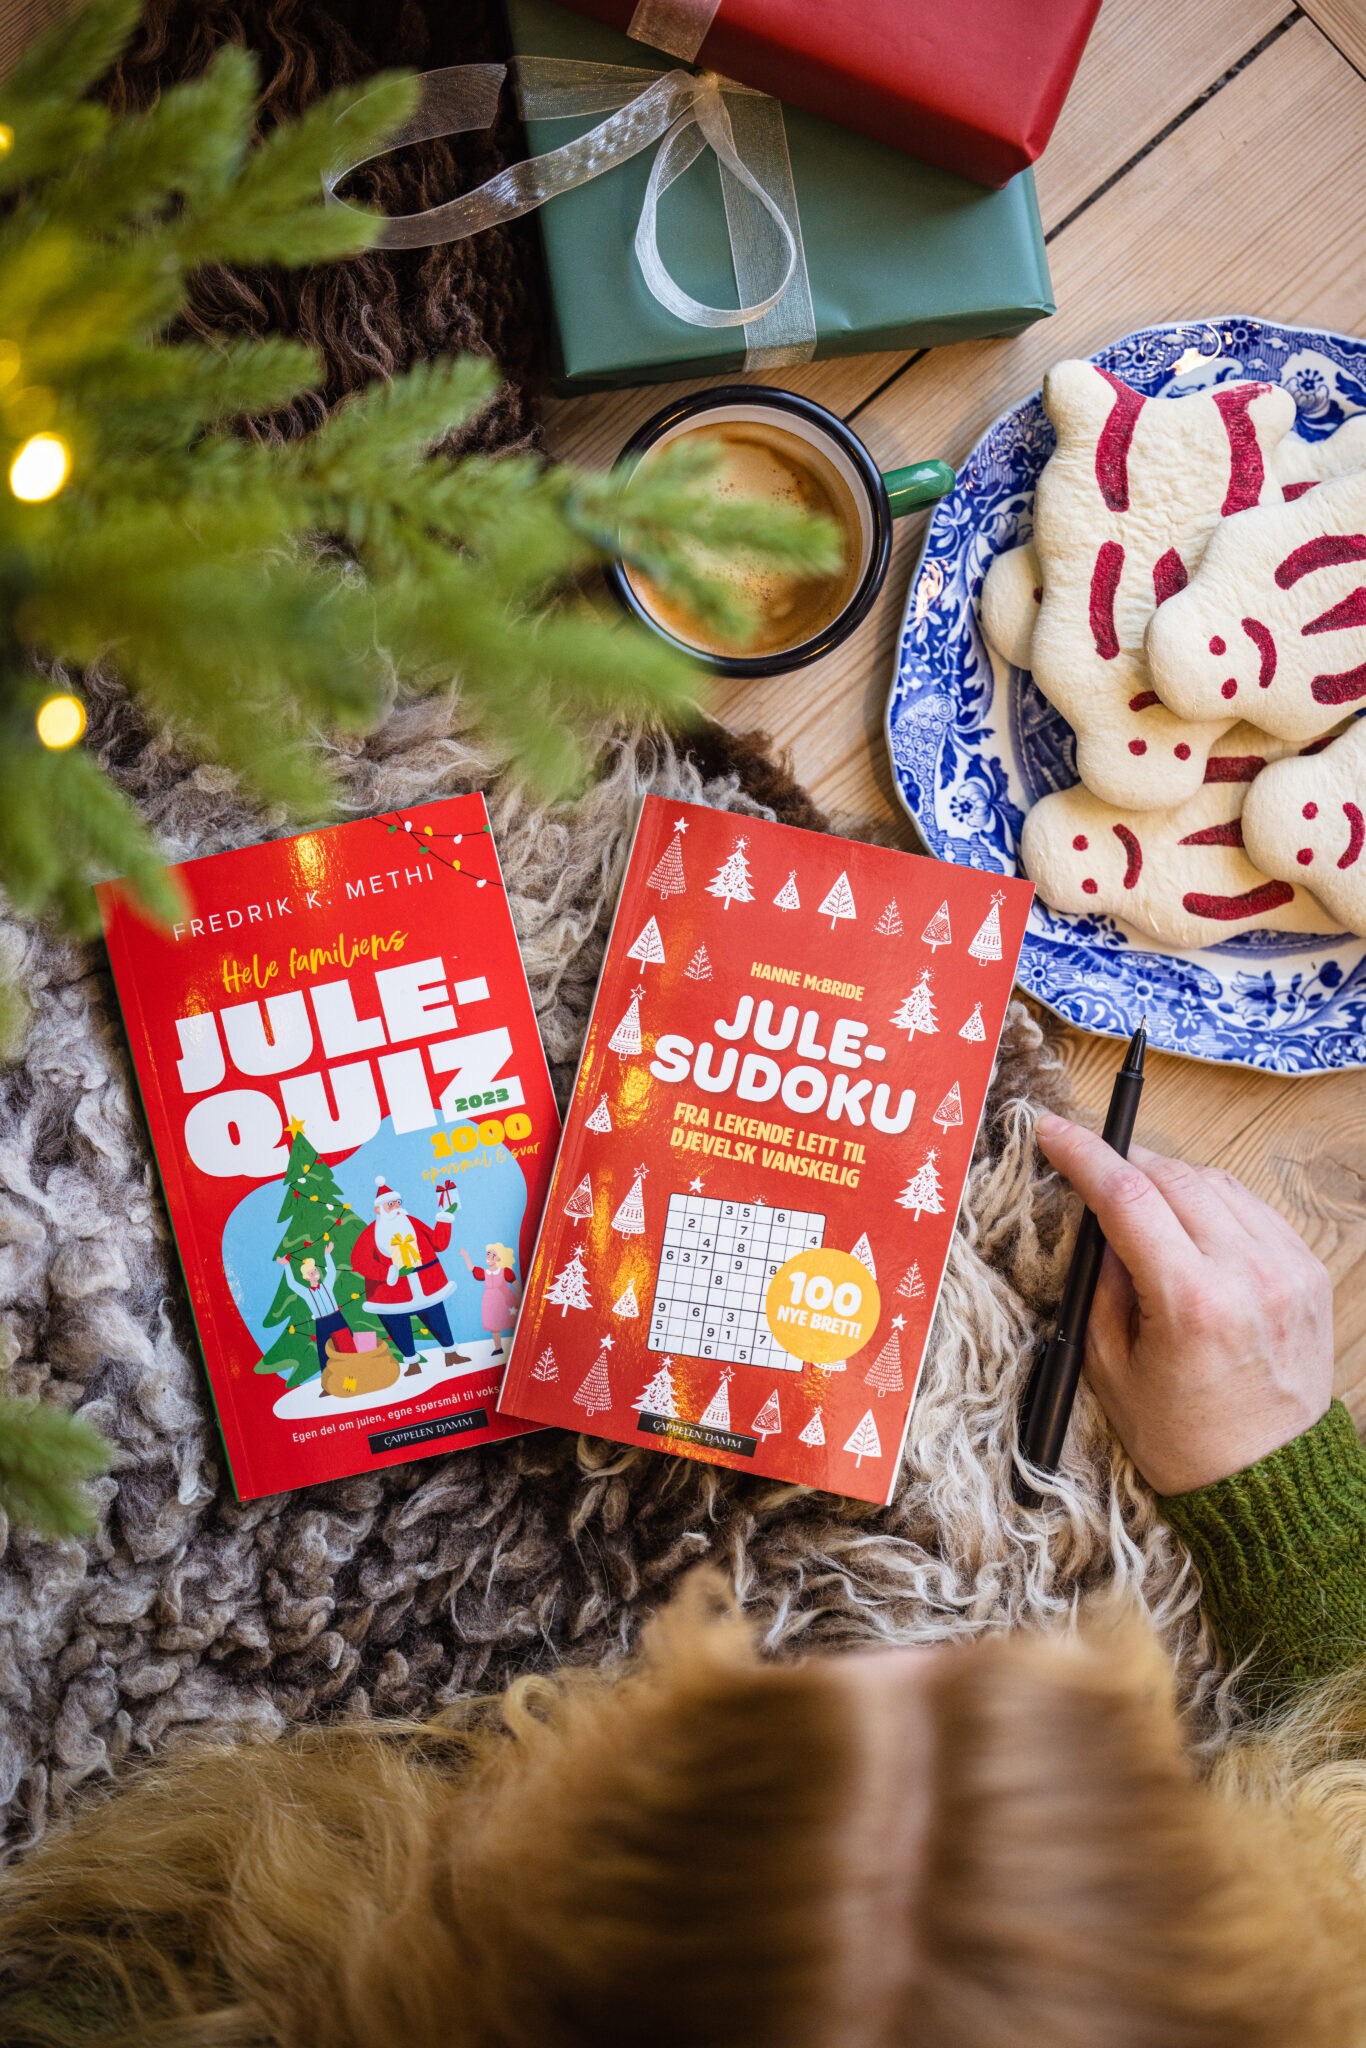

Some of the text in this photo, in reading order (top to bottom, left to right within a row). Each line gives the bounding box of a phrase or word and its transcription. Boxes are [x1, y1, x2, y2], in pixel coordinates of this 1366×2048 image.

[173, 863, 434, 942] FREDRIK K. METHI
[222, 930, 409, 993] Hele familiens
[750, 961, 865, 1001] HANNE McBRIDE
[174, 956, 491, 1094] JULE-
[713, 995, 887, 1069] JULE-
[455, 1088, 510, 1112] 2023
[649, 1034, 917, 1134] SUDOKU
[184, 1026, 526, 1178] QUIZ
[430, 1113, 533, 1159] 1000
[673, 1101, 866, 1164] FRA LEKENDE LETT TIL
[495, 1146, 507, 1164] &
[510, 1142, 541, 1159] svar
[669, 1126, 861, 1189] DJEVELSK VANSKELIG
[725, 1205, 785, 1223] 3 5 6
[688, 1218, 818, 1245] 2 7 4
[703, 1238, 745, 1253] 4 8
[666, 1250, 777, 1275] 6 3 7 9 8
[714, 1275, 723, 1285] 8
[789, 1271, 862, 1317] 100
[658, 1302, 735, 1322] 9 6 3
[776, 1305, 863, 1339] NYE BRETT!
[655, 1320, 767, 1344] 5 9 1 7
[655, 1338, 747, 1360] 1 6 5
[292, 1385, 502, 1443] Egen del om julen, egne spørsmål til voks
[384, 1417, 474, 1447] CAPPELEN DAMM
[652, 1420, 742, 1449] CAPPELEN DAMM
